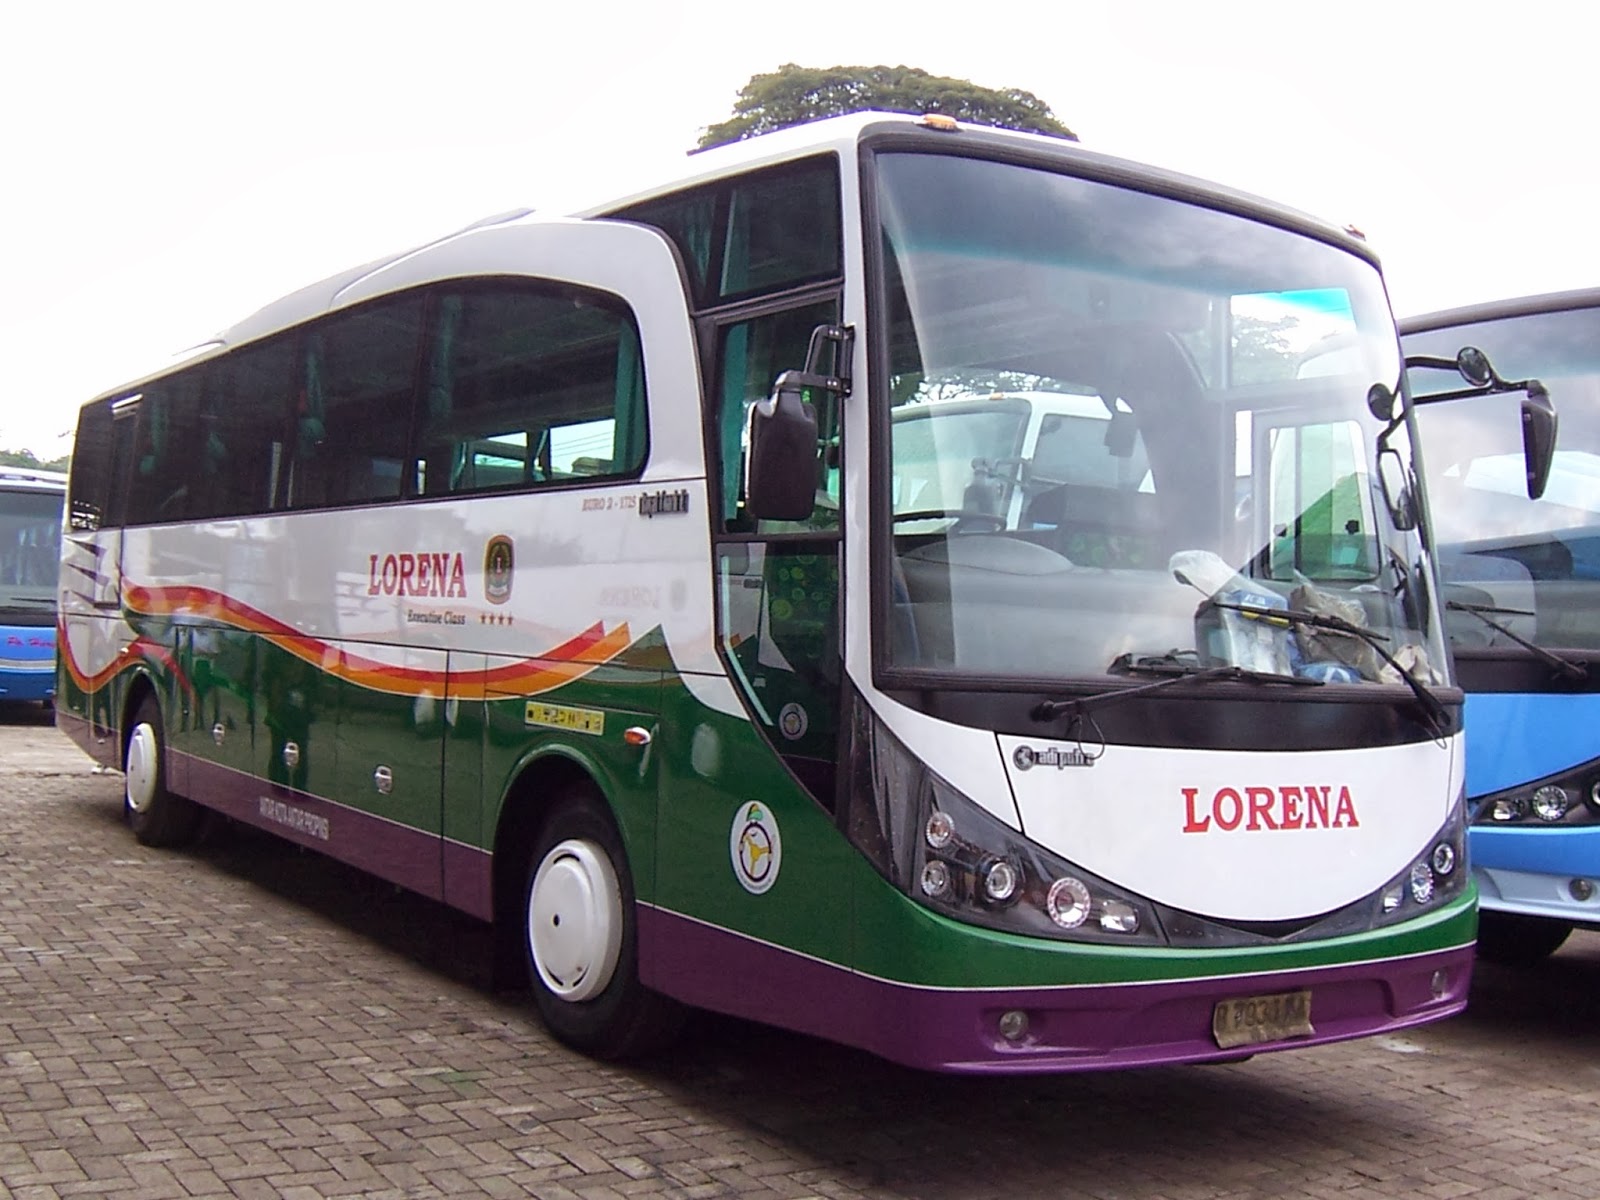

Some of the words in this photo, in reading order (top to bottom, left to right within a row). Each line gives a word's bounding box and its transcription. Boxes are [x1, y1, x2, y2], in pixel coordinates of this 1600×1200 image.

[368, 552, 467, 598] LORENA
[407, 610, 442, 624] Executive
[444, 611, 466, 625] Class
[1181, 786, 1359, 833] LORENA
